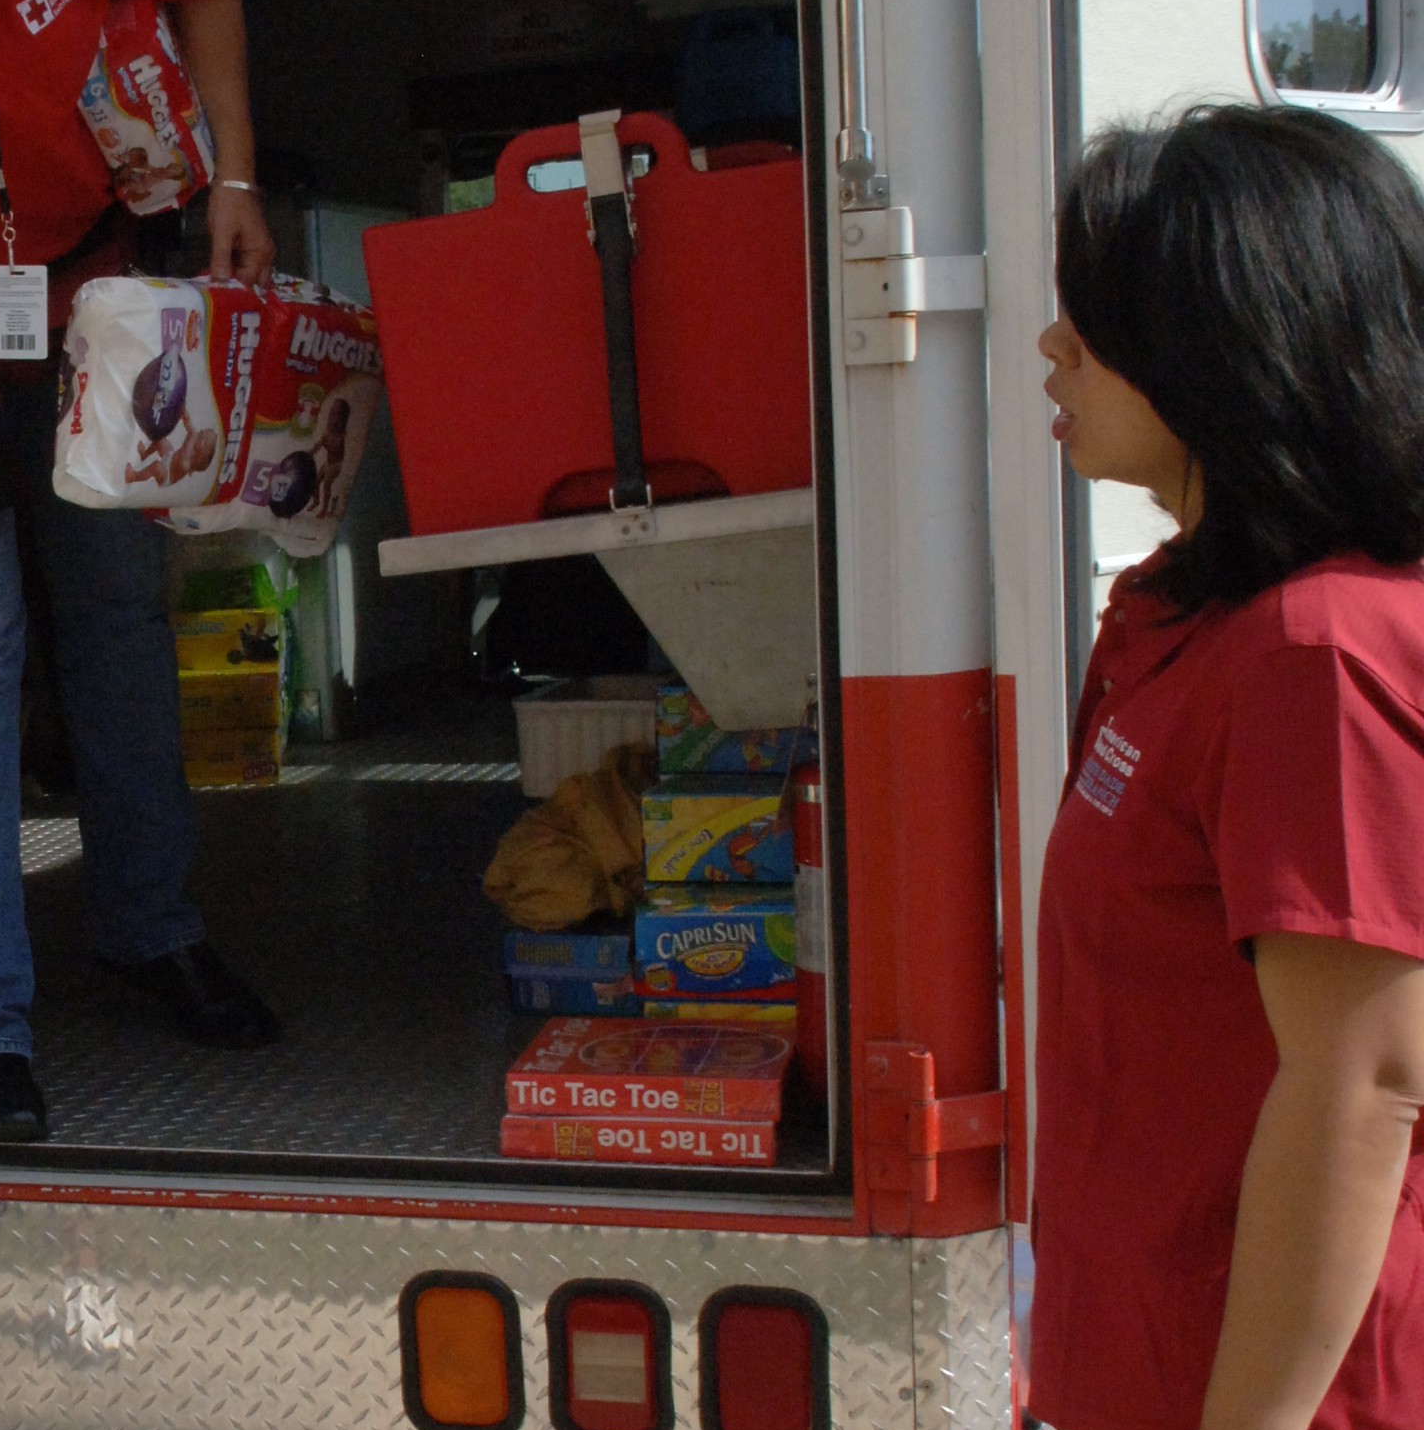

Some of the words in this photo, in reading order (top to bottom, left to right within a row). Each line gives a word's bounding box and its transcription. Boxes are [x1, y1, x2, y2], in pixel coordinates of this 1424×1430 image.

[128, 54, 181, 149] HUGGIES
[169, 319, 184, 339] 5
[218, 311, 262, 486] HUGGIES
[252, 472, 270, 492] 5
[511, 1080, 557, 1106] Tic
[564, 1081, 617, 1108] Tac
[624, 1083, 680, 1110] Toe
[596, 1127, 653, 1154] Toe
[659, 1129, 714, 1157] Tac
[720, 1131, 768, 1159] Tic
